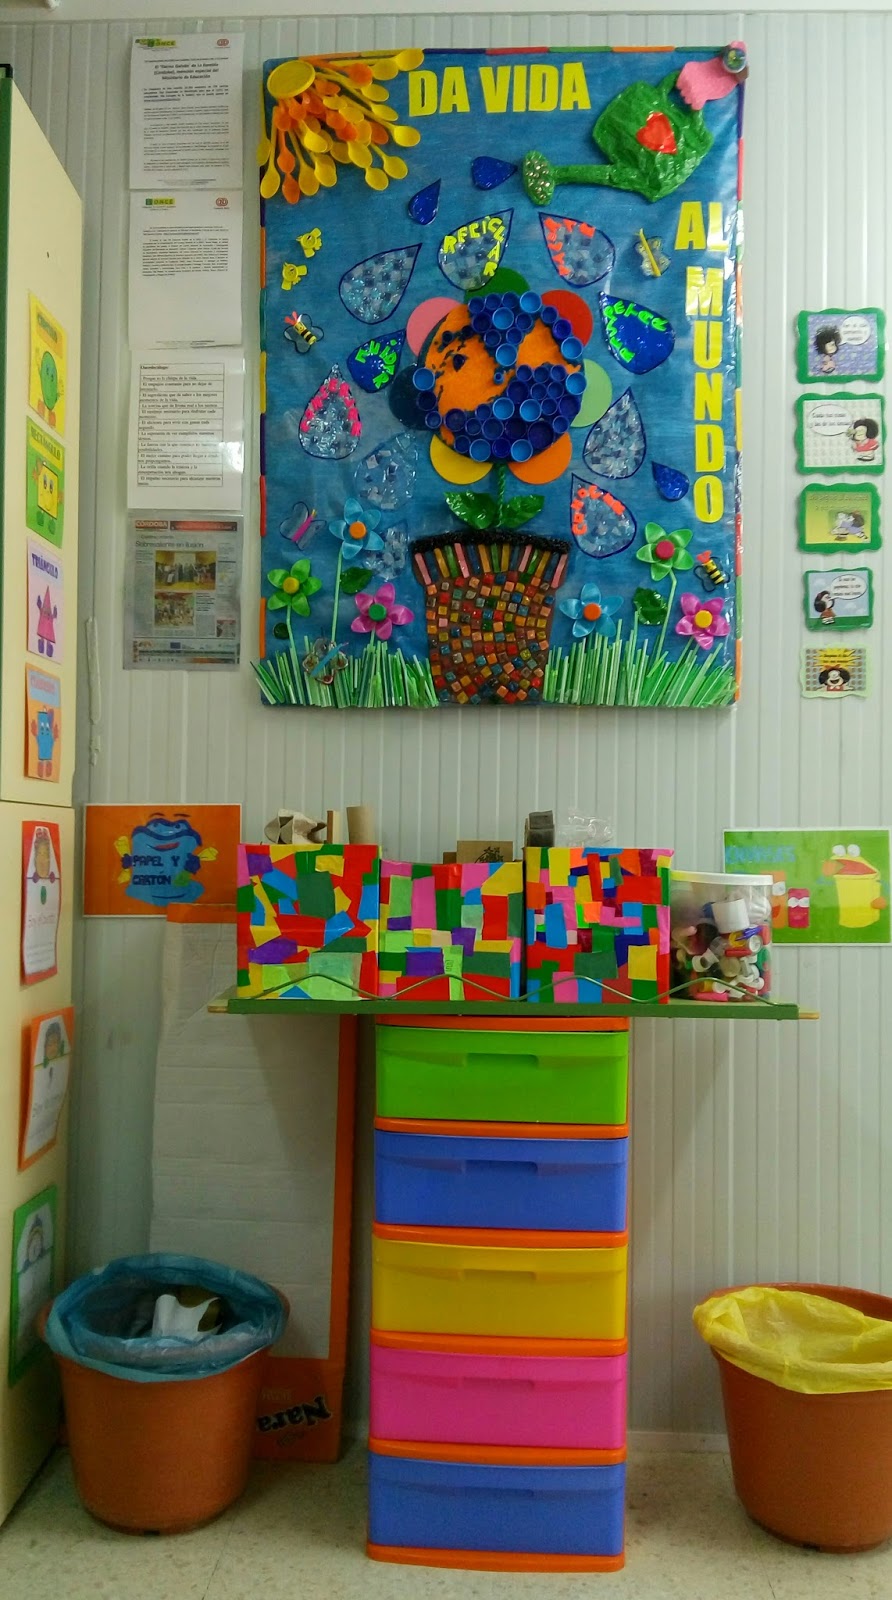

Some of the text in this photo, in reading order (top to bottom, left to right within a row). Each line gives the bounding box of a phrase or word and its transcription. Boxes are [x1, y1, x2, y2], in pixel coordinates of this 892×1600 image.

[408, 62, 591, 117] DA VIDA
[675, 202, 728, 251] AL
[685, 266, 724, 523] MUNDO
[133, 855, 180, 867] PAPEL Y
[133, 871, 171, 885] CARTÓN
